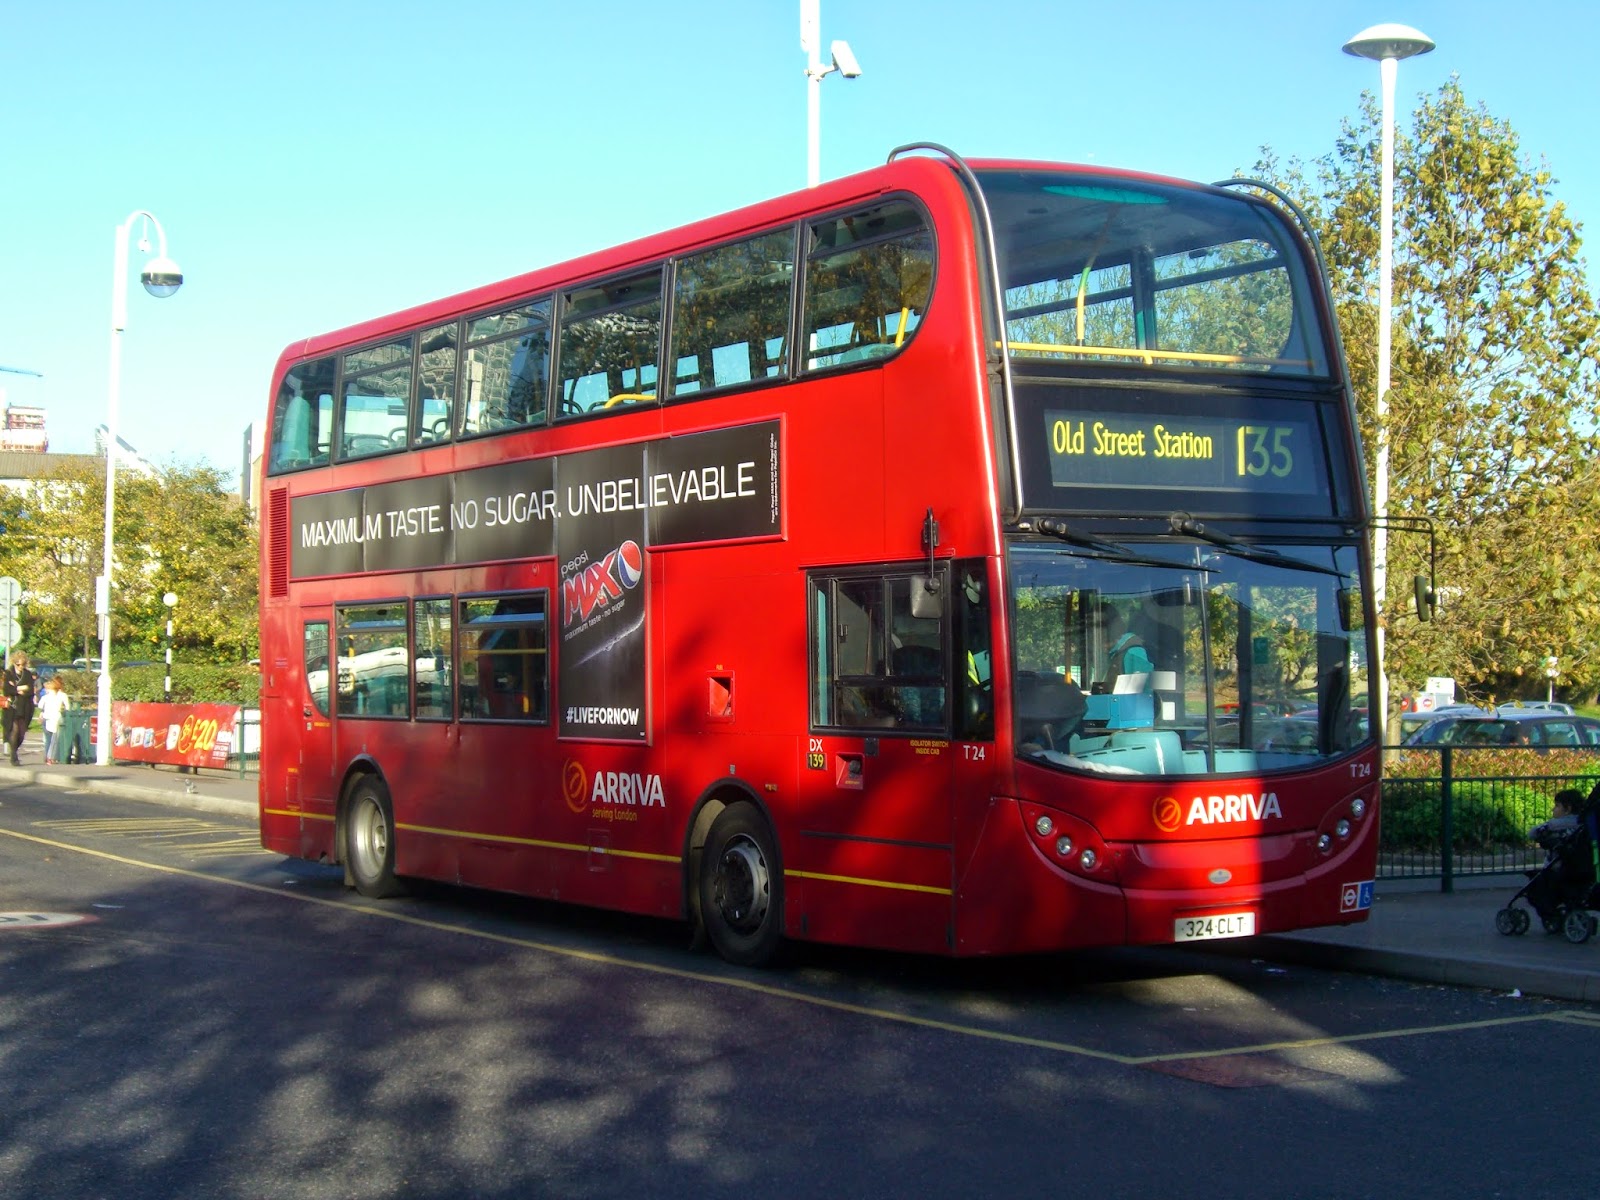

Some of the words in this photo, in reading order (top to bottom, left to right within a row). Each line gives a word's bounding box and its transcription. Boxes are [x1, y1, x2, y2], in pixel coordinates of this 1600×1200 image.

[1053, 420, 1085, 455] Old
[1093, 421, 1145, 457] Street
[1153, 424, 1213, 459] Station
[1237, 425, 1294, 477] 135
[302, 513, 382, 548] MAXIMUM
[386, 505, 444, 538] TASTE.
[450, 499, 478, 530] NO
[485, 489, 562, 527] SUGAR.
[567, 461, 756, 516] UNBELIEVABLE
[560, 550, 589, 578] pepsi
[563, 548, 624, 628] MAX
[566, 706, 639, 726] #LIVEFORNOW
[808, 753, 824, 768] 139
[809, 738, 823, 752] DX
[591, 771, 666, 807] ARRIVA
[592, 808, 613, 822] serving
[614, 808, 638, 822] London
[1186, 792, 1282, 826] ARRIVA
[1186, 919, 1213, 937] 324
[1217, 916, 1245, 935] CLT
